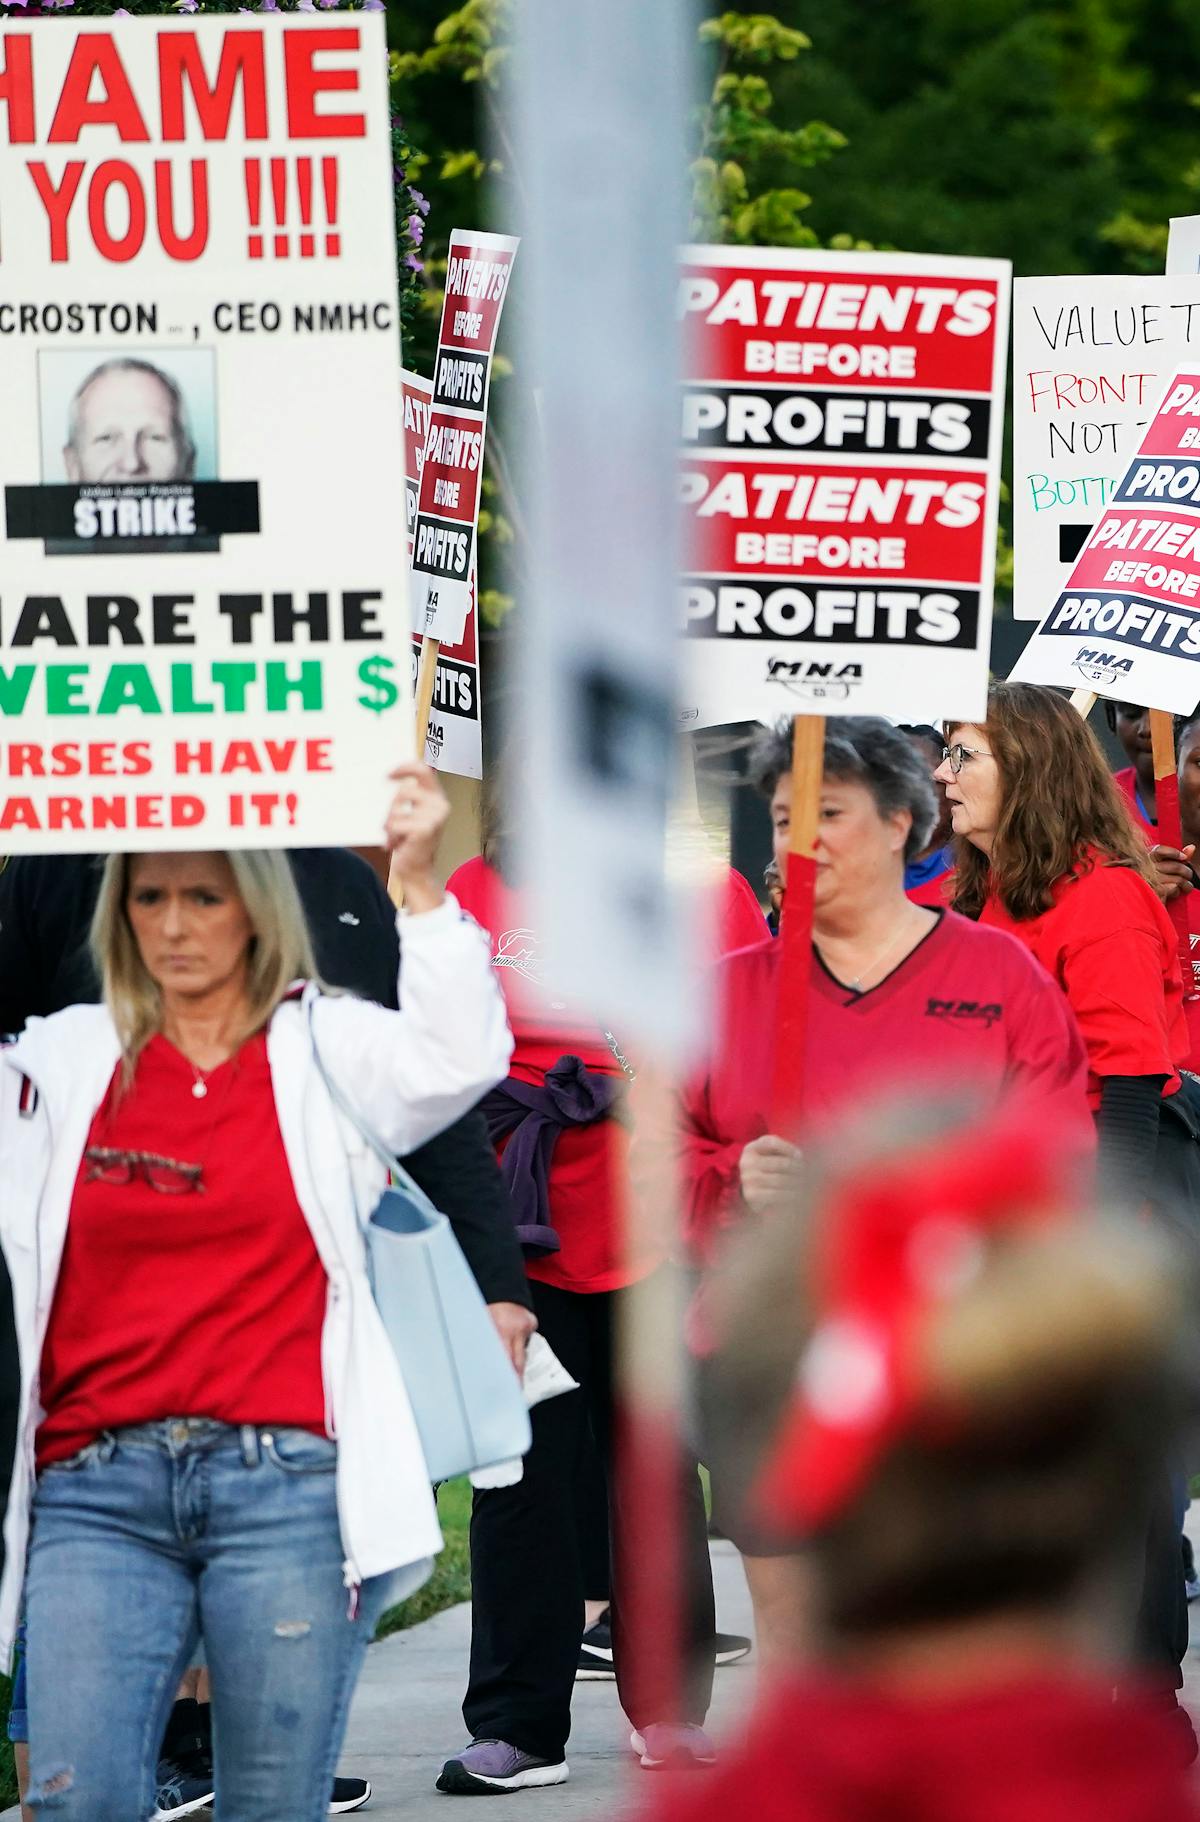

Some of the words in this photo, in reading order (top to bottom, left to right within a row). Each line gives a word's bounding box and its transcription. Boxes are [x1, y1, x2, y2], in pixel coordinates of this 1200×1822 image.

[26, 158, 210, 264] YOU
[447, 257, 510, 302] PATIENTS
[214, 302, 281, 333] CEO
[292, 301, 391, 332] NMHC
[676, 278, 996, 337] PATIENTS
[1033, 305, 1164, 350] VALUE
[745, 341, 917, 379] BEFORE
[1027, 370, 1157, 412] FRONT
[681, 394, 972, 453] PROFITS
[1049, 421, 1122, 458] NOT
[73, 497, 197, 538] STRIKE
[676, 471, 986, 528] PATIENTS
[416, 523, 468, 574] PRFITS
[735, 533, 906, 569] BEFORE
[0, 593, 196, 648] ARE
[219, 591, 384, 643] THE
[681, 586, 961, 643] PROFITS
[357, 652, 401, 718] $
[770, 662, 862, 677] MNA
[0, 741, 153, 778] RSES
[174, 738, 334, 775] HAVE
[229, 792, 298, 827] IT!
